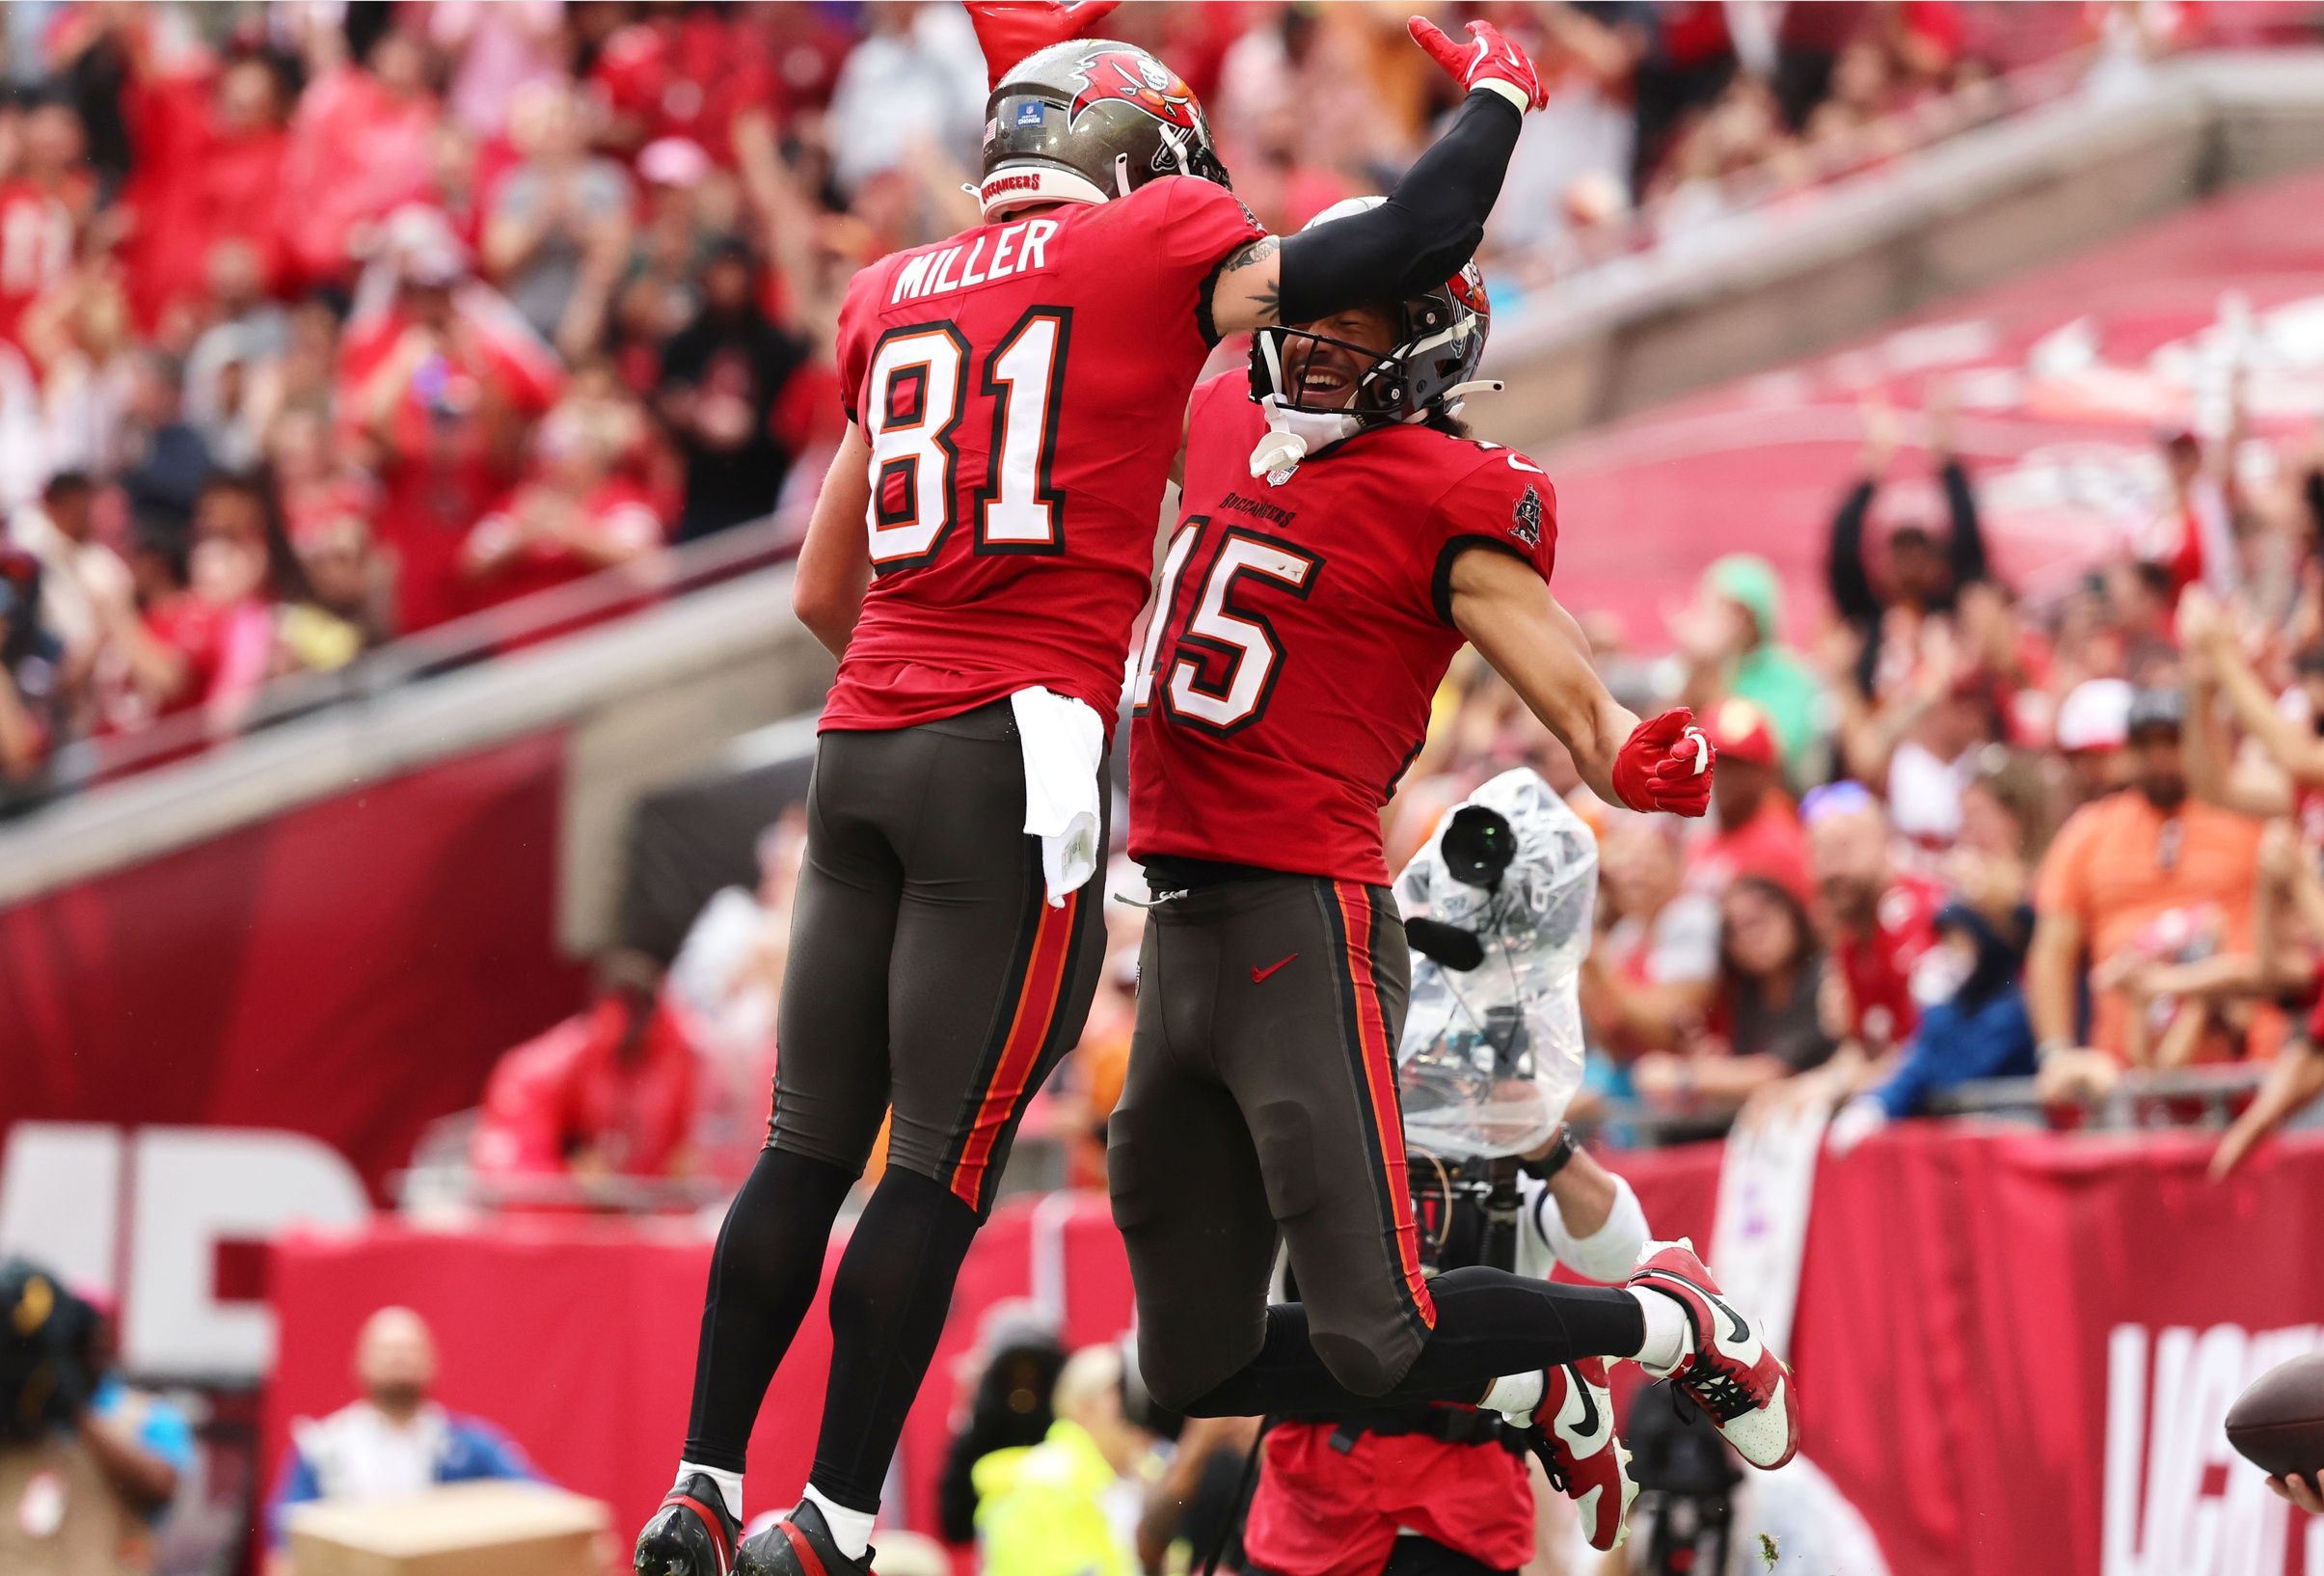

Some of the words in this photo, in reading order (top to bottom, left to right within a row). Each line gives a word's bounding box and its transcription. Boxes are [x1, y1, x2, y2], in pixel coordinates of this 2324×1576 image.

[890, 219, 1059, 305] MILLER
[866, 305, 1074, 577] 81
[1219, 492, 1297, 529] BUCCANEERS
[1132, 514, 1327, 741] 15
